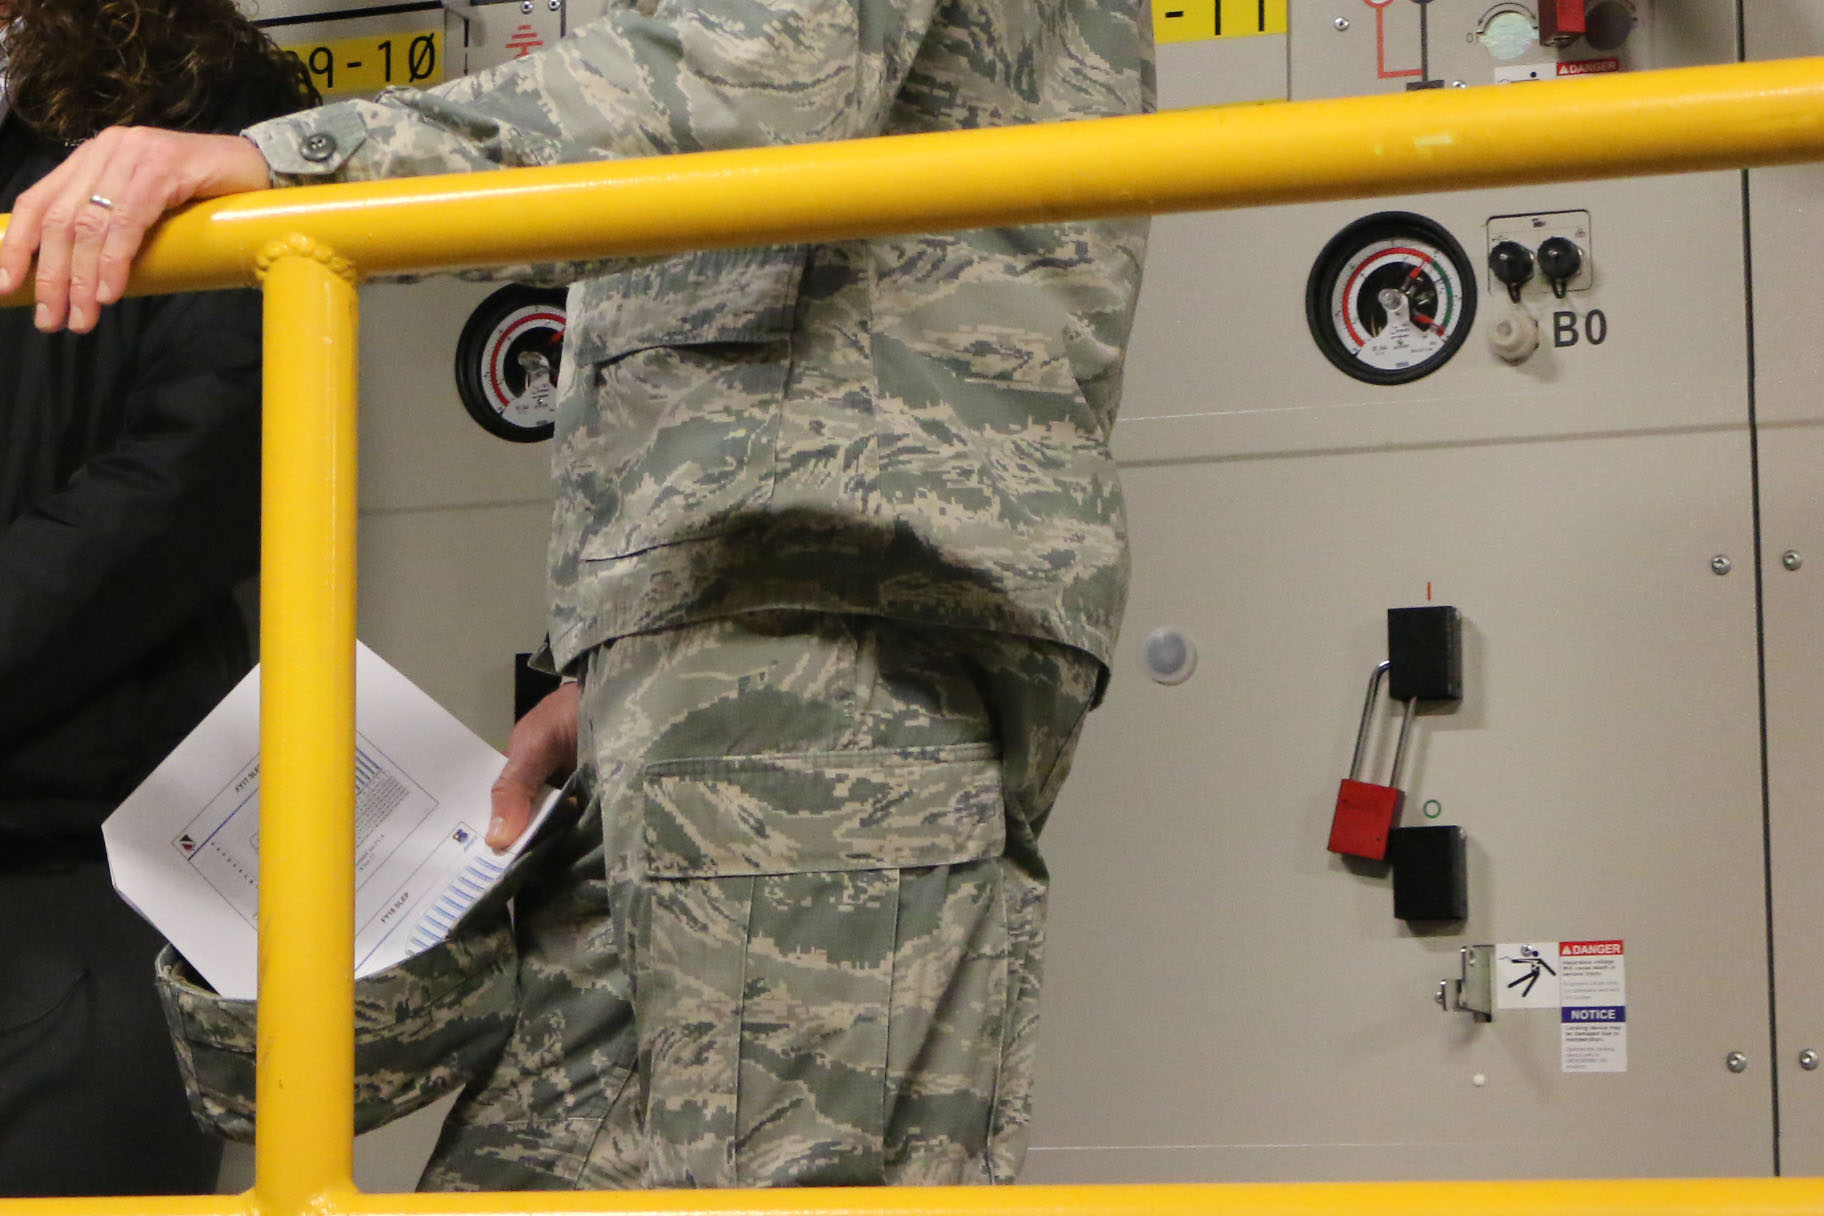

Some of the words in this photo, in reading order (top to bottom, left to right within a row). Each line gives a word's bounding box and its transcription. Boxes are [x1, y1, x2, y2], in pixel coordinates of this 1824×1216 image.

[284, 32, 436, 89] 9-10
[1569, 60, 1617, 74] DANGER
[1553, 308, 1607, 348] B0
[1572, 943, 1622, 955] DANGER
[1570, 1009, 1616, 1020] NOTICE
